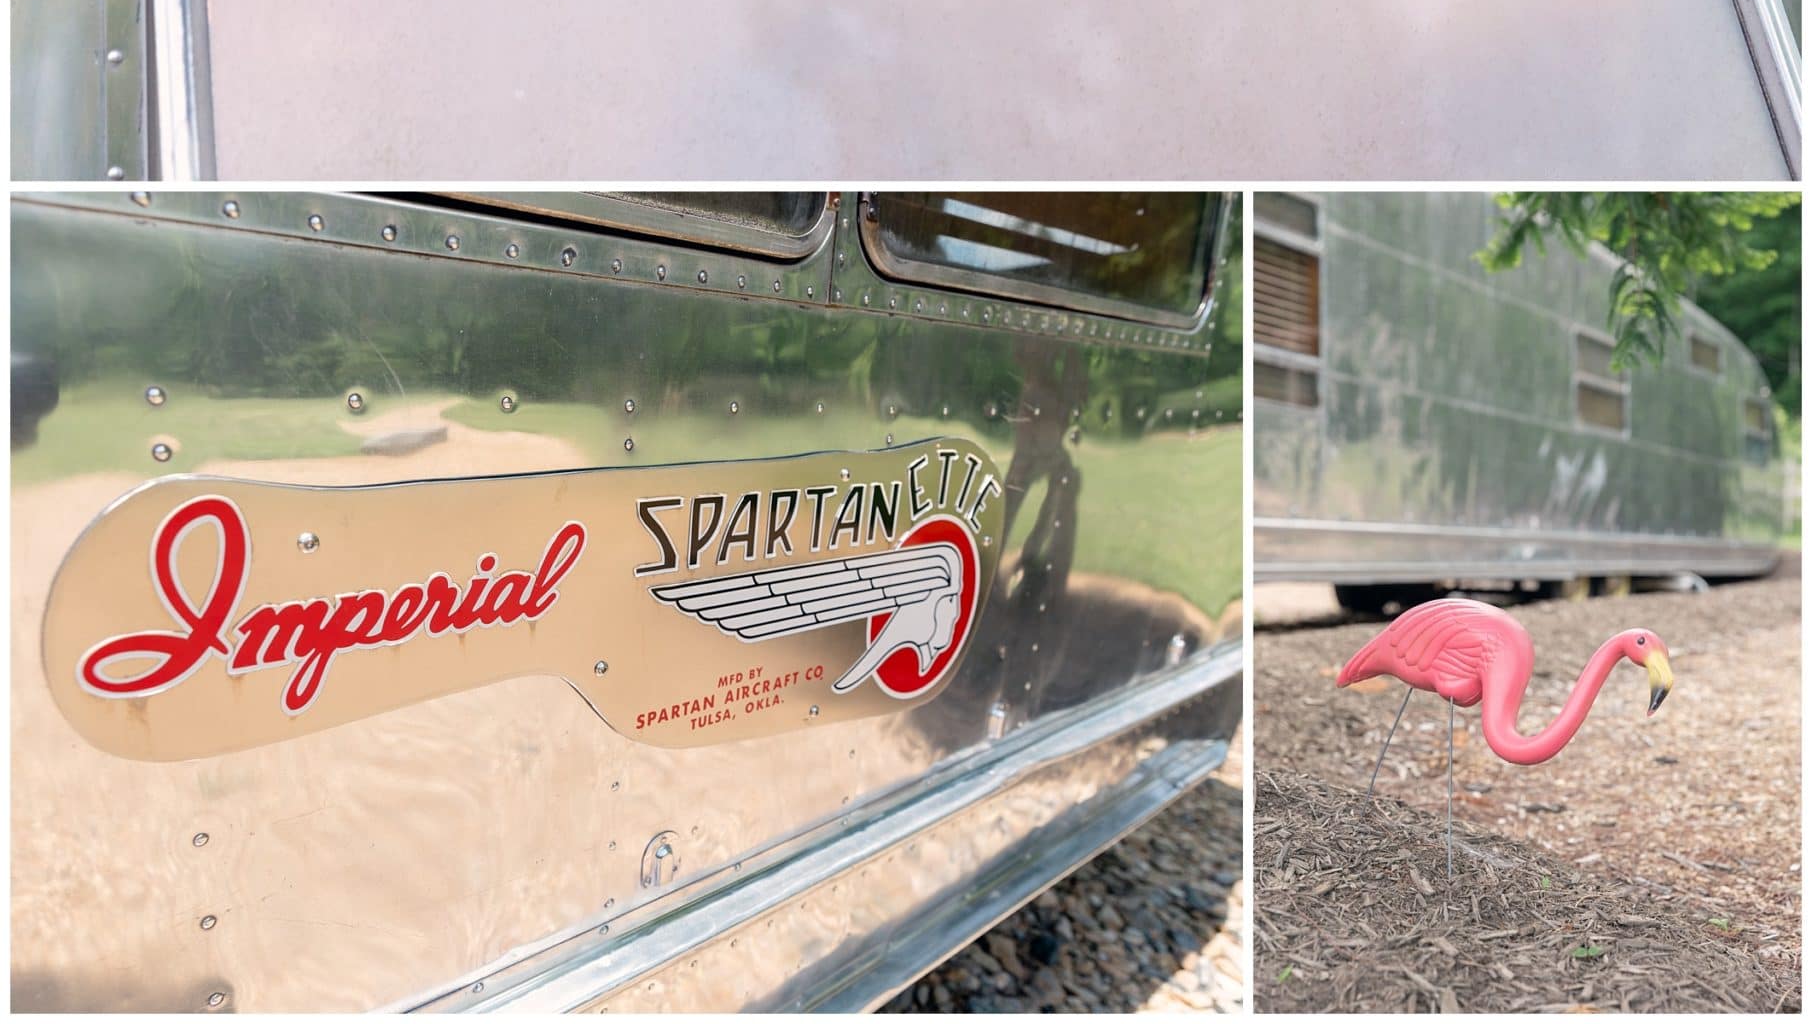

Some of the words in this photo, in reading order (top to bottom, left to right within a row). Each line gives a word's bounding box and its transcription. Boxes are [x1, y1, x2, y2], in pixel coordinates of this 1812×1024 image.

[76, 494, 588, 716] Imperial
[635, 694, 716, 730] SPARTAN
[724, 671, 799, 705] AIRCRAFT
[717, 673, 743, 689] MFD
[749, 666, 764, 680] BY
[690, 707, 736, 731] TULSA,
[744, 694, 785, 714] OKLA.
